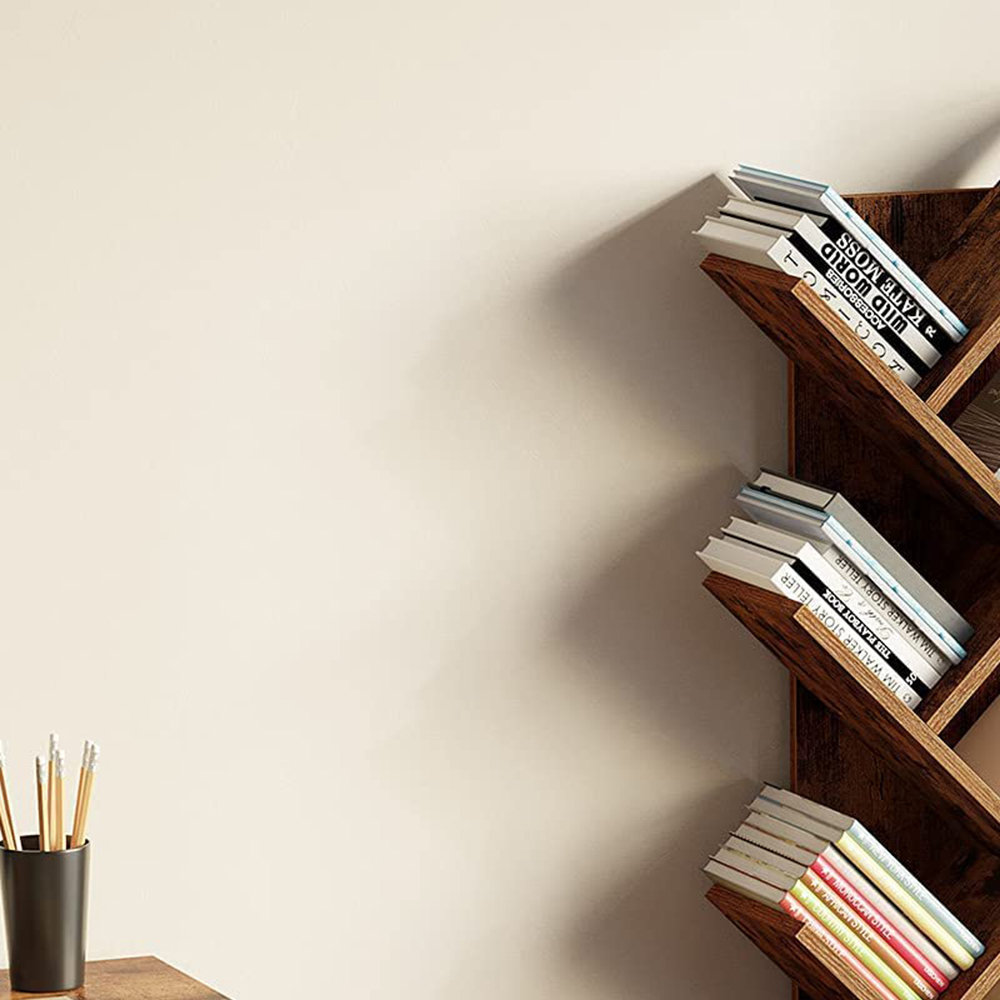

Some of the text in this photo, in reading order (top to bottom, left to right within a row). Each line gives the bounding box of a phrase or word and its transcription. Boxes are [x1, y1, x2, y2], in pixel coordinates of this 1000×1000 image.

[819, 240, 908, 334] WILD WORLD
[834, 230, 885, 282] MOSS
[824, 268, 885, 331] ACCESSORIES
[879, 276, 927, 326] KATE
[779, 571, 901, 692] TIM WALKER STORY TELLER
[821, 588, 891, 659] THE PLAYBOY BOOK
[834, 555, 936, 657] TIM WALKER STORY TELLER
